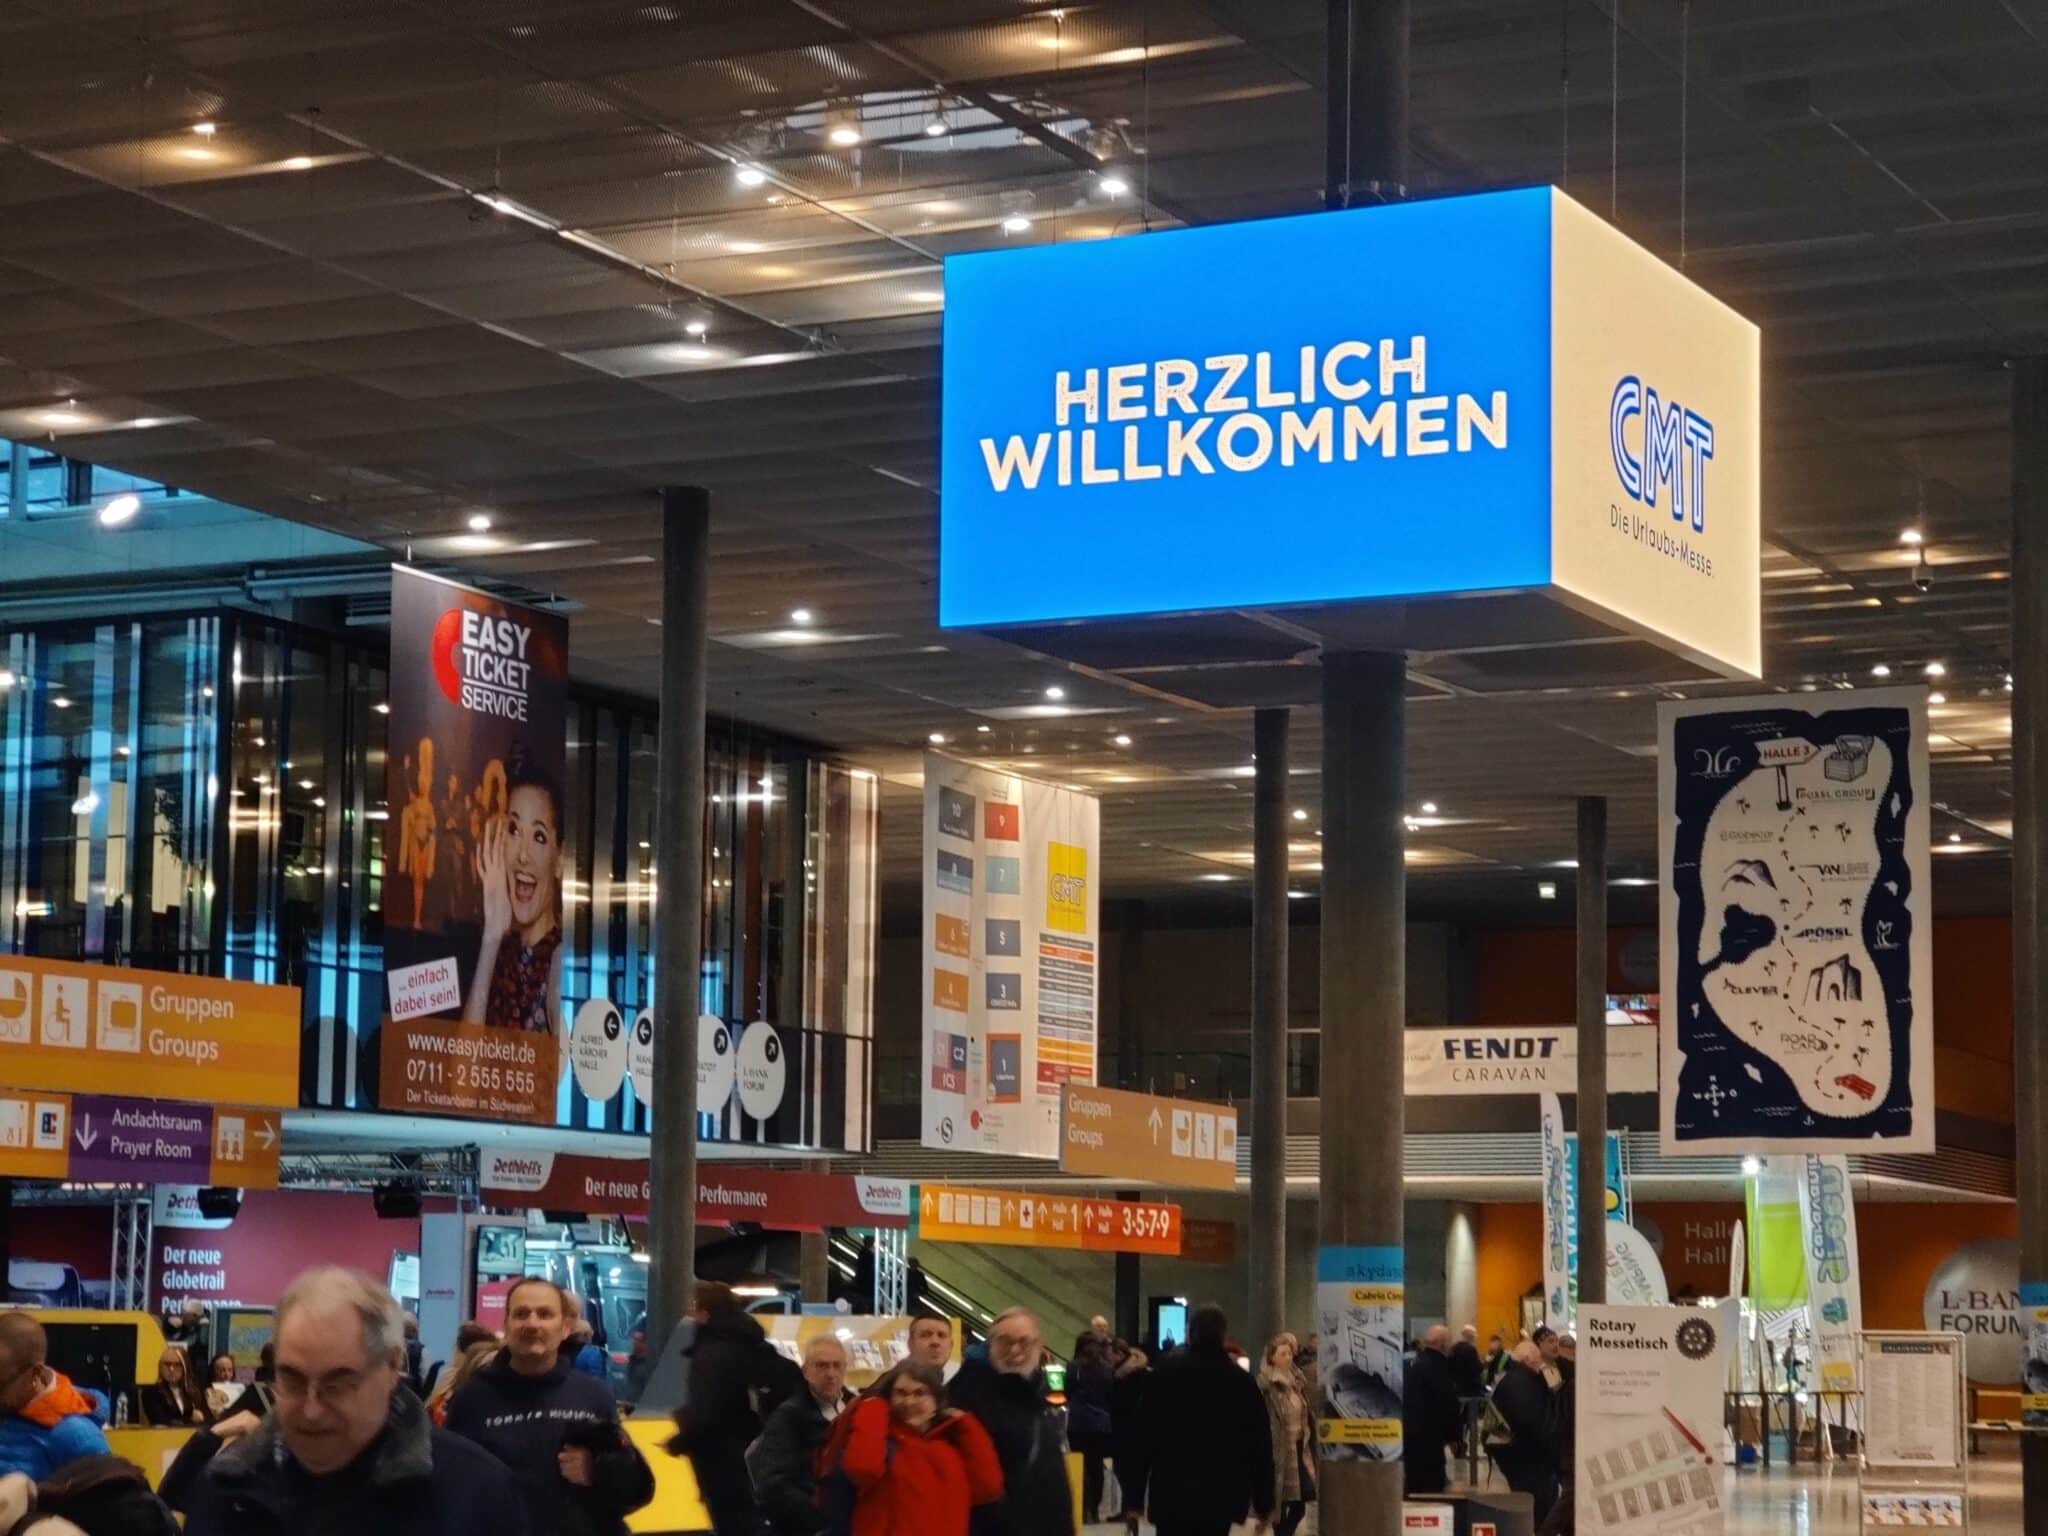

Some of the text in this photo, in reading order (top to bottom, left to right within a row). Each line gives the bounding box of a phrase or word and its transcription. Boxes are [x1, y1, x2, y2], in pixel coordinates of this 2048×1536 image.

[1055, 335, 1427, 426] HERZLICH
[980, 391, 1508, 492] WILLKOMMEN
[1609, 375, 1714, 534] CMT
[1610, 504, 1629, 535] Die
[462, 610, 531, 660] EASY
[462, 647, 530, 691] TICKET
[461, 686, 528, 723] SERVICE
[1763, 743, 1800, 760] HALLE
[1051, 873, 1085, 906] CMT
[150, 985, 234, 1020] Gruppen
[394, 985, 457, 1014] dabei sein!
[1731, 985, 1778, 996] CLEVER
[149, 1029, 219, 1065] Groups
[407, 1033, 536, 1064] www.easyticket.de
[1443, 1037, 1559, 1060] FENDT
[406, 1059, 443, 1084] 0711
[456, 1064, 466, 1087] 2
[470, 1066, 501, 1090] 555
[505, 1071, 535, 1094] 555
[1452, 1067, 1547, 1082] CARAVAN
[406, 1088, 422, 1103] Der
[1068, 1095, 1111, 1118] Gruppen
[112, 1109, 202, 1133] Andachtsraum
[1067, 1124, 1104, 1150] Groups
[111, 1138, 192, 1161] Prayer Room
[585, 1177, 606, 1197] Der
[608, 1181, 638, 1199] neue
[700, 1184, 768, 1208] Performance
[1070, 1203, 1078, 1232] 1
[163, 1245, 222, 1265] Der neue
[1685, 1246, 1726, 1264] Hall
[162, 1269, 225, 1291] Globetrail
[1941, 1289, 2022, 1311] L-BAN
[1589, 1318, 1637, 1337] Rotary
[1589, 1336, 1669, 1353] Messetisch
